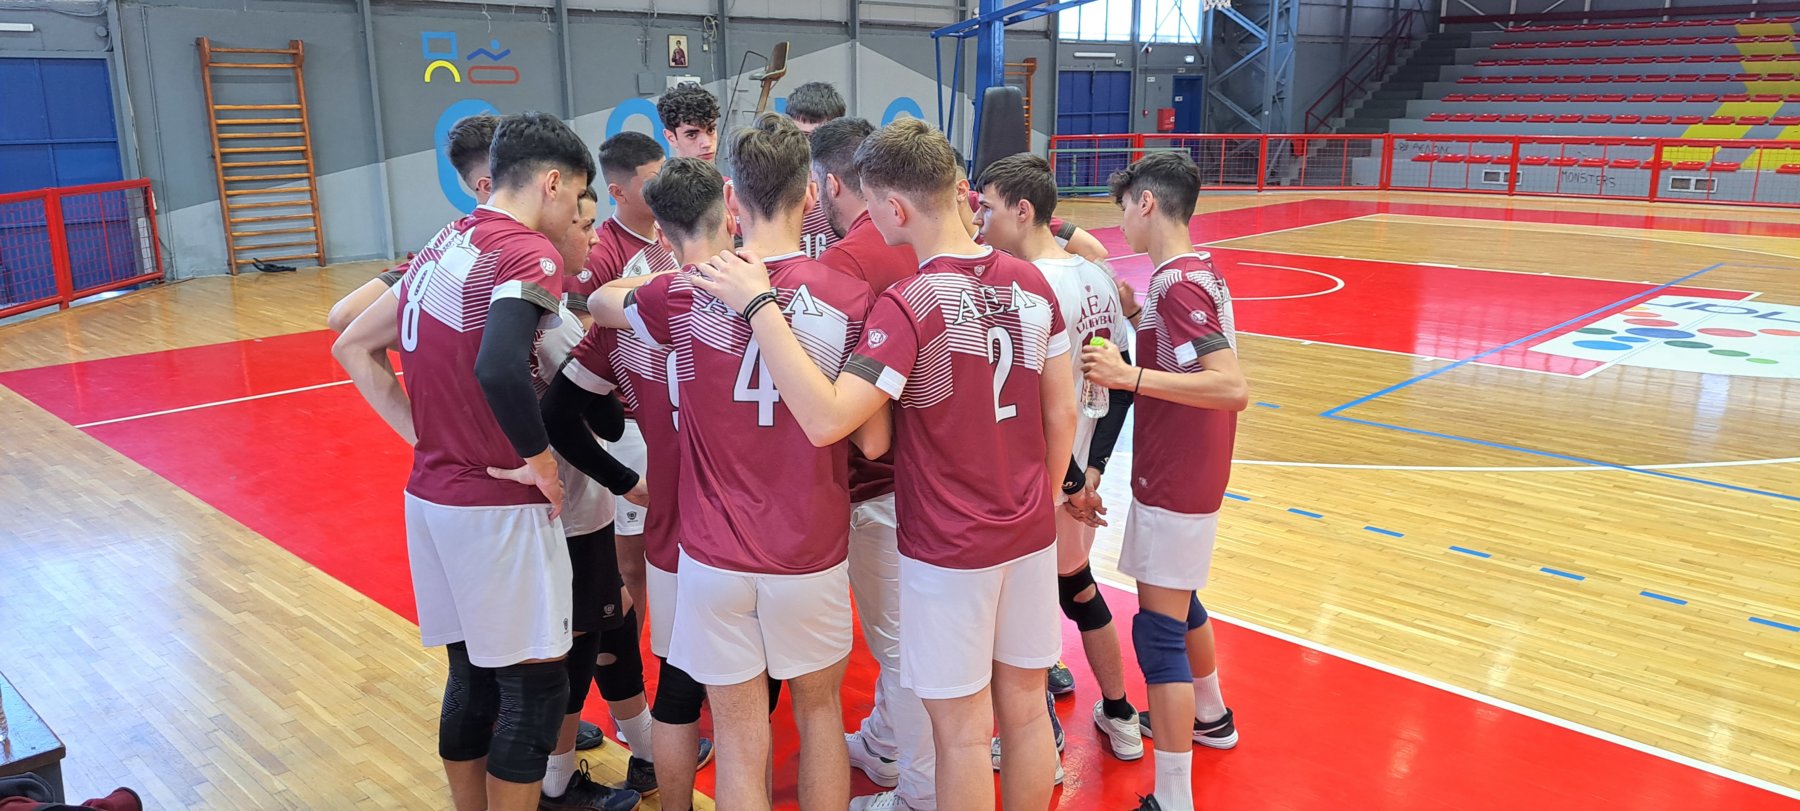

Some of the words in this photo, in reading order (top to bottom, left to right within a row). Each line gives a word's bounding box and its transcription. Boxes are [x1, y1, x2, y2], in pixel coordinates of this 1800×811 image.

[1561, 171, 1616, 188] MONSTERS
[402, 260, 437, 352] 8
[733, 329, 780, 427] 4
[987, 326, 1017, 423] 2
